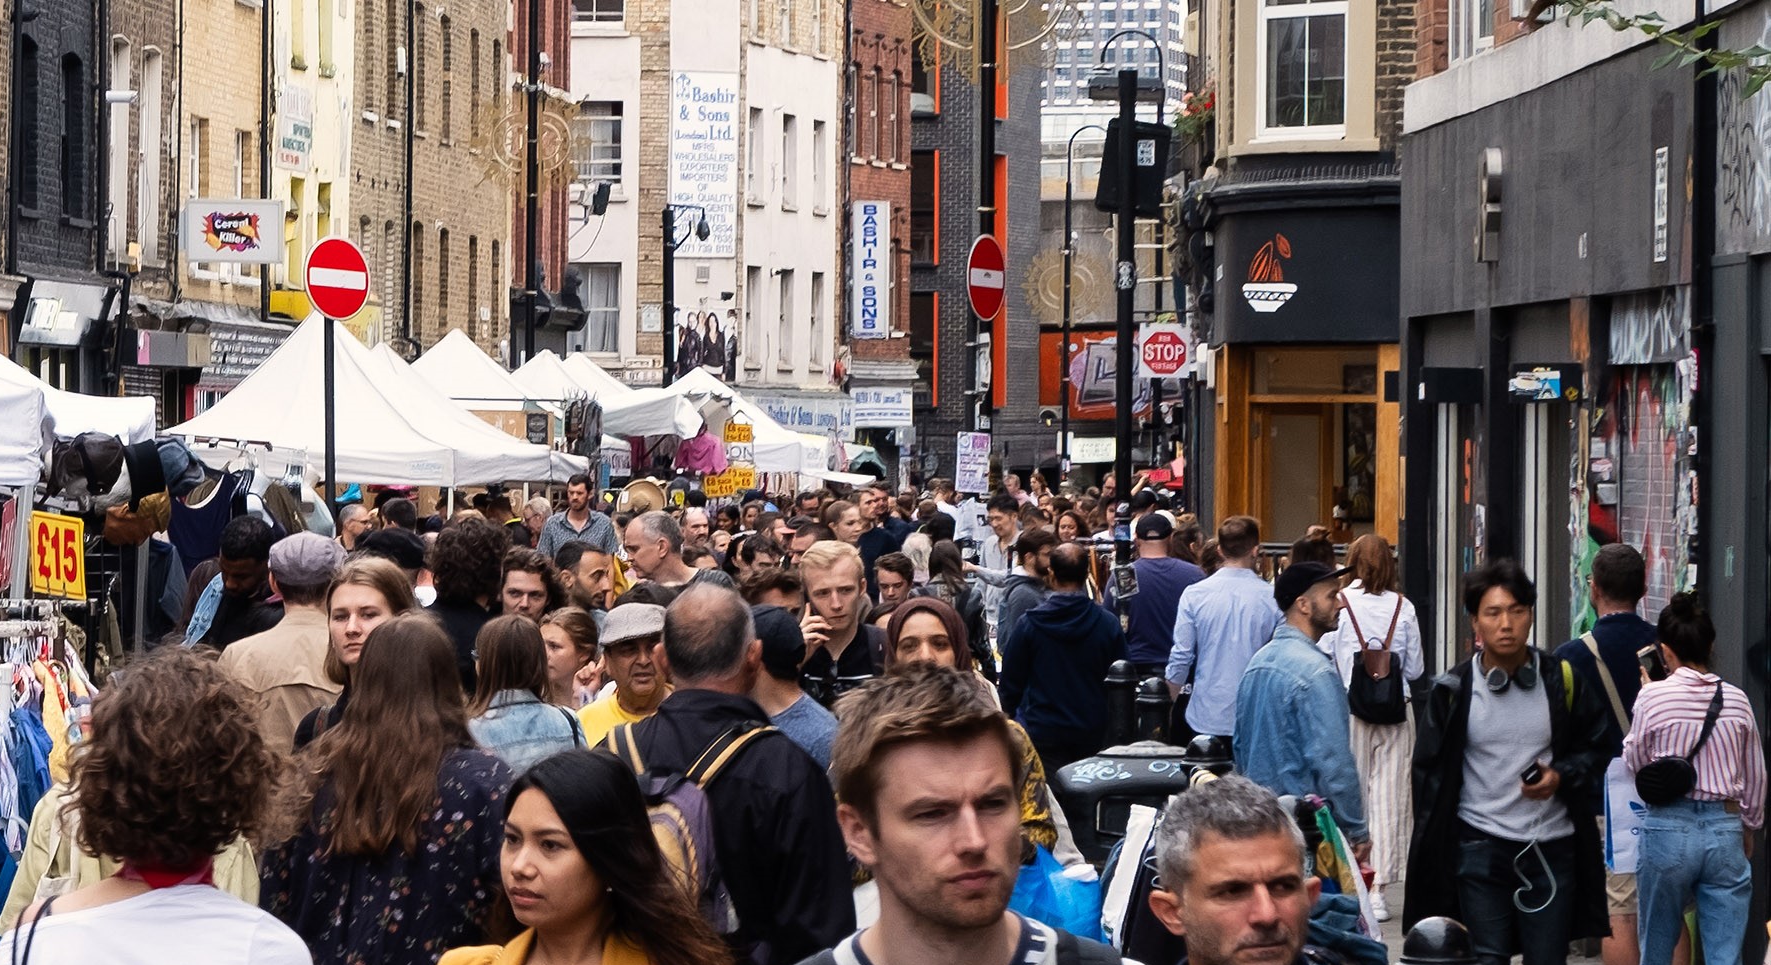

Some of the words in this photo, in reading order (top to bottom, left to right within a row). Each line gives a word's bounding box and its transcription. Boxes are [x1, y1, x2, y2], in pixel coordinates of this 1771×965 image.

[692, 87, 736, 103] Bashir
[680, 104, 690, 120] &
[698, 105, 730, 122] Sons
[674, 153, 735, 162] WHOLESALERS
[679, 163, 728, 172] EXPORTERS
[680, 173, 727, 182] IMPORTERS
[697, 182, 708, 192] OF
[674, 193, 693, 201] HIGH
[697, 193, 733, 202] QUALITY
[862, 205, 878, 269] BASHIR
[862, 286, 877, 329] SONS
[1144, 343, 1185, 361] STOP
[37, 522, 77, 583] £15
